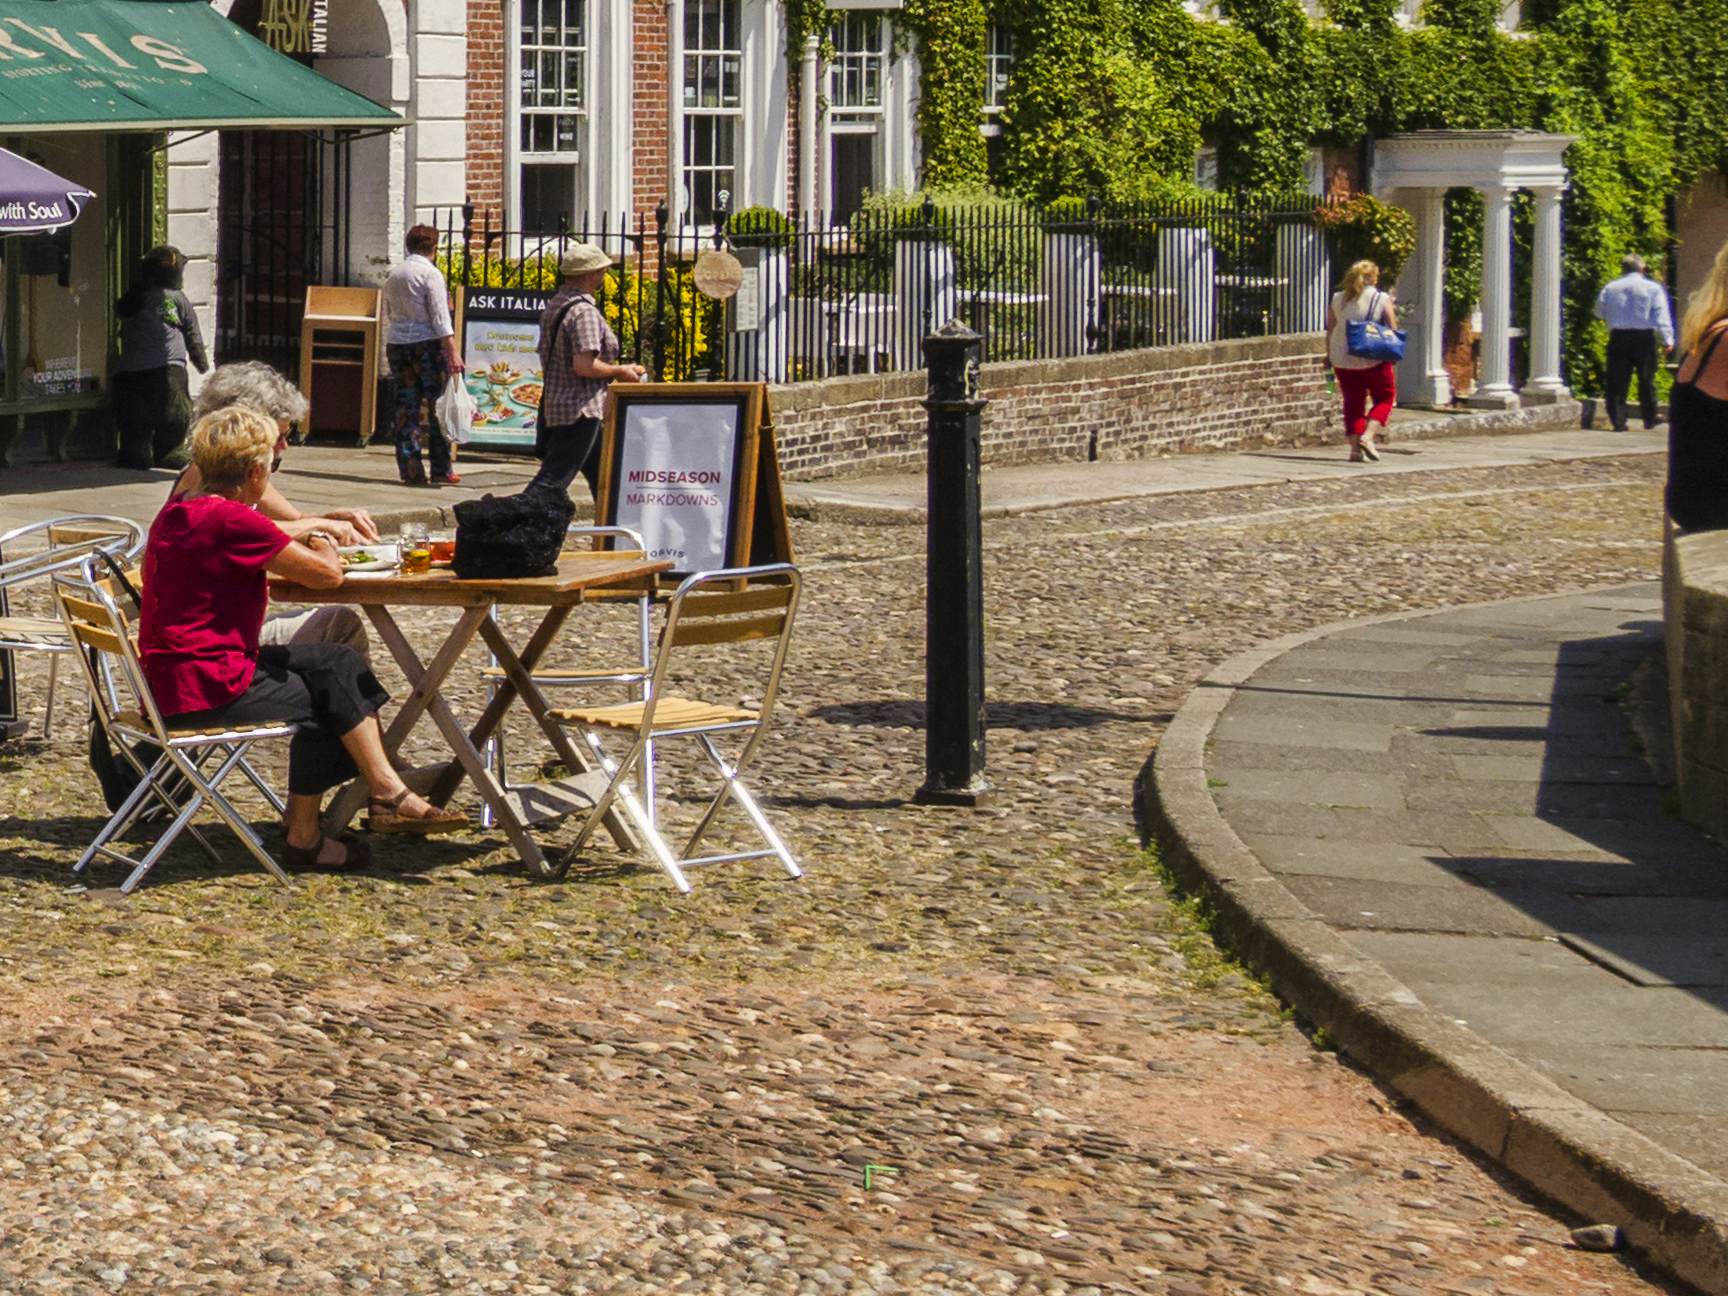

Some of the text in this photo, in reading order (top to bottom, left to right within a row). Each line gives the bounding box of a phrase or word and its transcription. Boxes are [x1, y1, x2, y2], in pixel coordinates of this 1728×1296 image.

[28, 200, 63, 220] Soul
[469, 296, 548, 311] ASK ITALIA
[627, 470, 721, 484] MIDSEASON
[626, 494, 719, 507] MARKDOWNS
[650, 548, 686, 558] ORVIS
